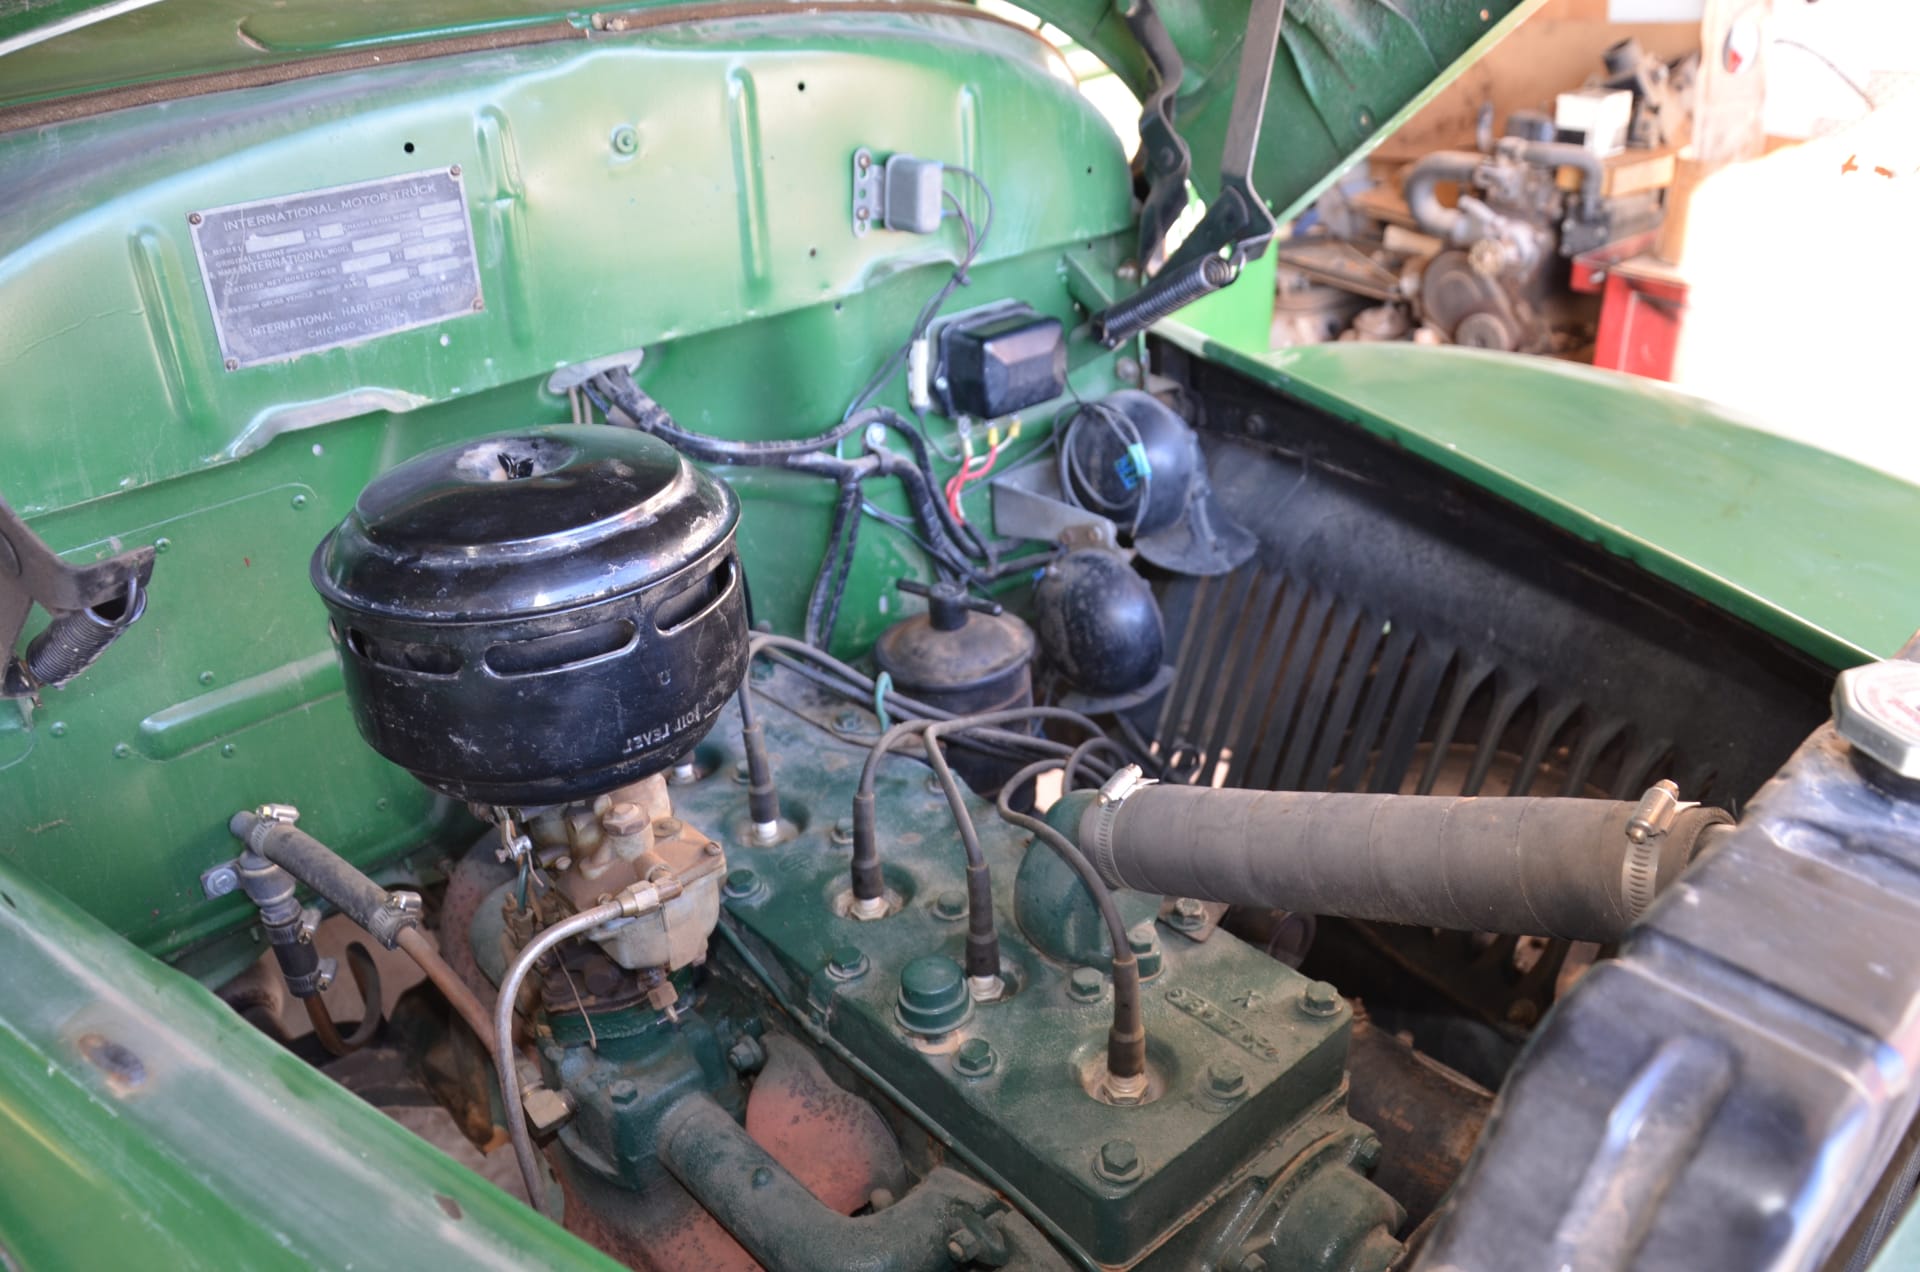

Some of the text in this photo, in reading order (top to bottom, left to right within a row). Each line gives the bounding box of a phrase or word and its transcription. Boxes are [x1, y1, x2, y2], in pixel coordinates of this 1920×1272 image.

[223, 182, 437, 232] INTERNATIONAL MOTOR TRUCK
[239, 248, 328, 273] INTERNATIONAL
[250, 311, 335, 337] INTERNATIONAL
